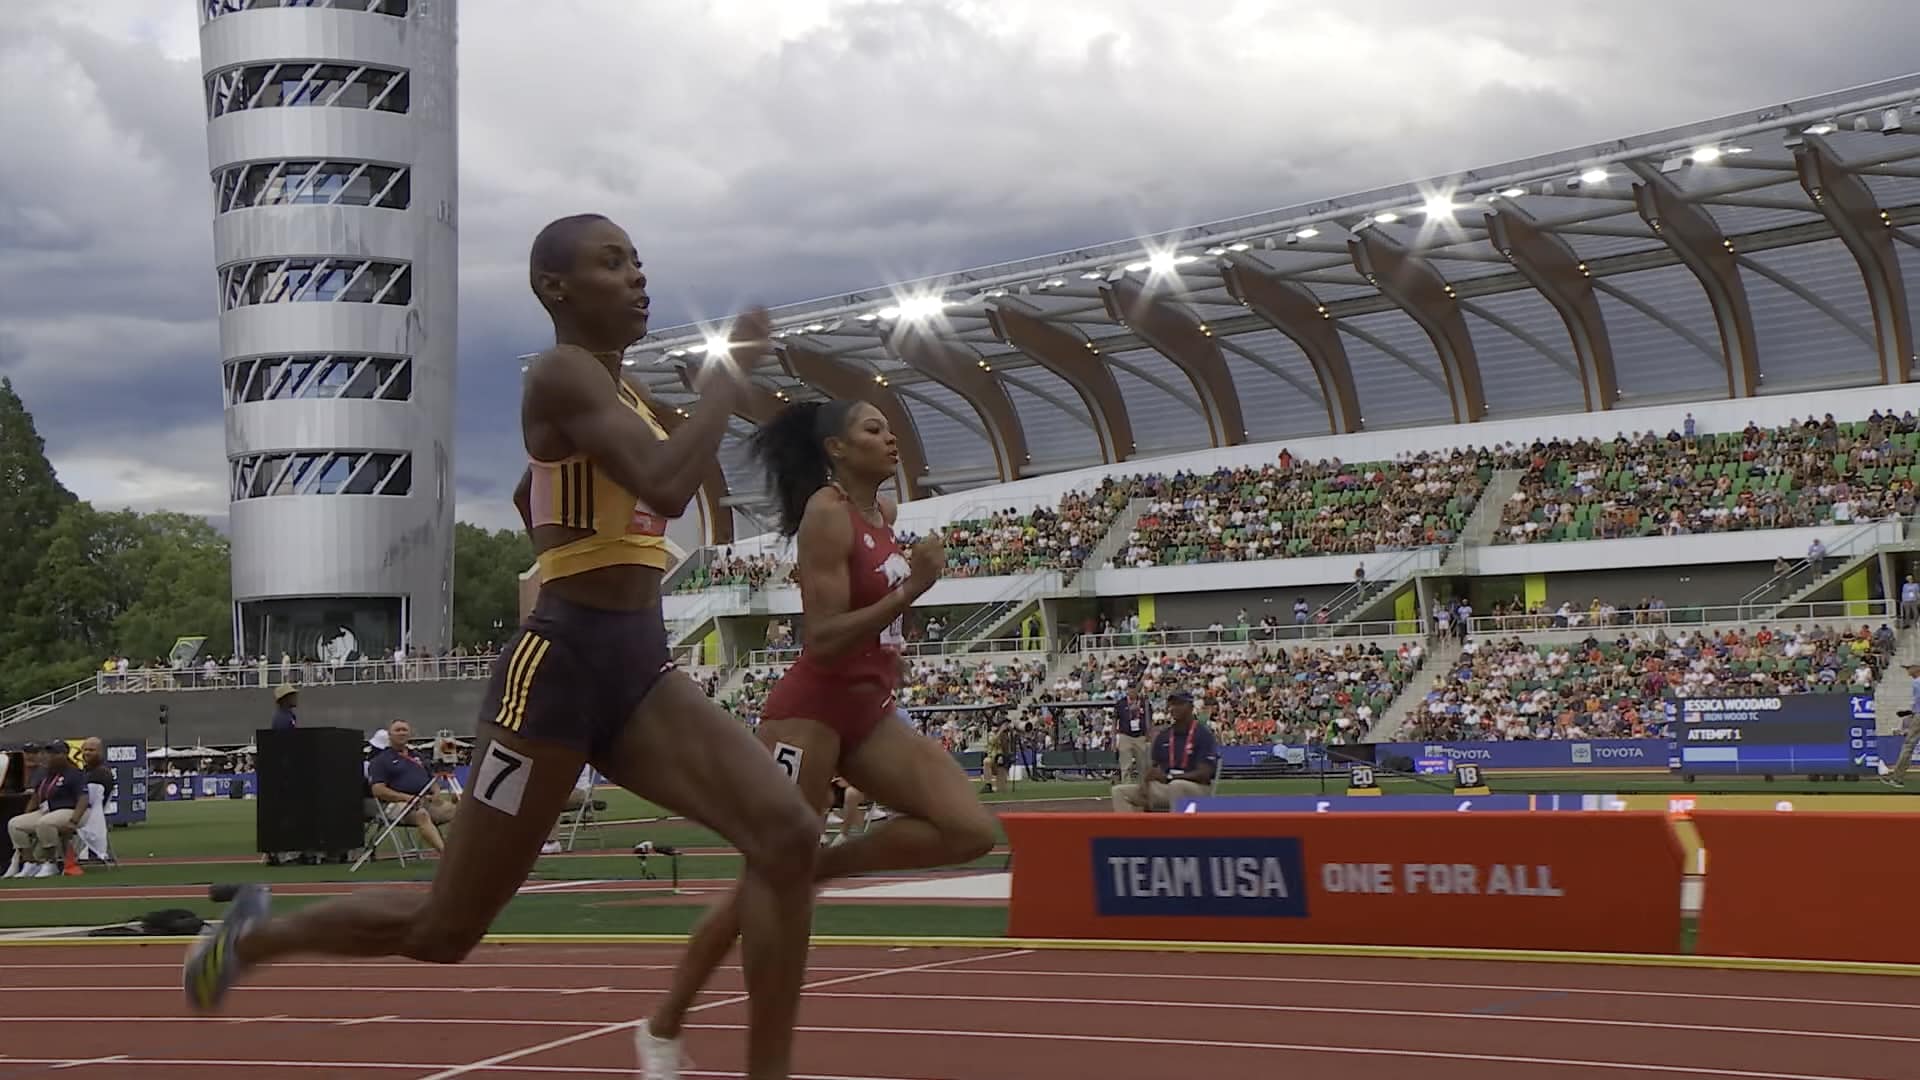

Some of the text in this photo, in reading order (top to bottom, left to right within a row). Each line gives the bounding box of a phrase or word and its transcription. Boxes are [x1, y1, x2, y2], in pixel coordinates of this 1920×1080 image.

[1684, 698, 1781, 711] JESSICA WOODARD
[1688, 729, 1732, 740] ATTEMPT
[1734, 729, 1742, 739] 1
[1448, 749, 1491, 759] TOYOTA
[1595, 748, 1644, 758] TOYOTA
[777, 748, 796, 776] 5
[484, 747, 522, 801] 7
[1353, 769, 1374, 785] 20
[1458, 767, 1478, 785] 18
[1107, 857, 1289, 898] TEAM USA
[1323, 863, 1566, 897] ONE FOR ALL
